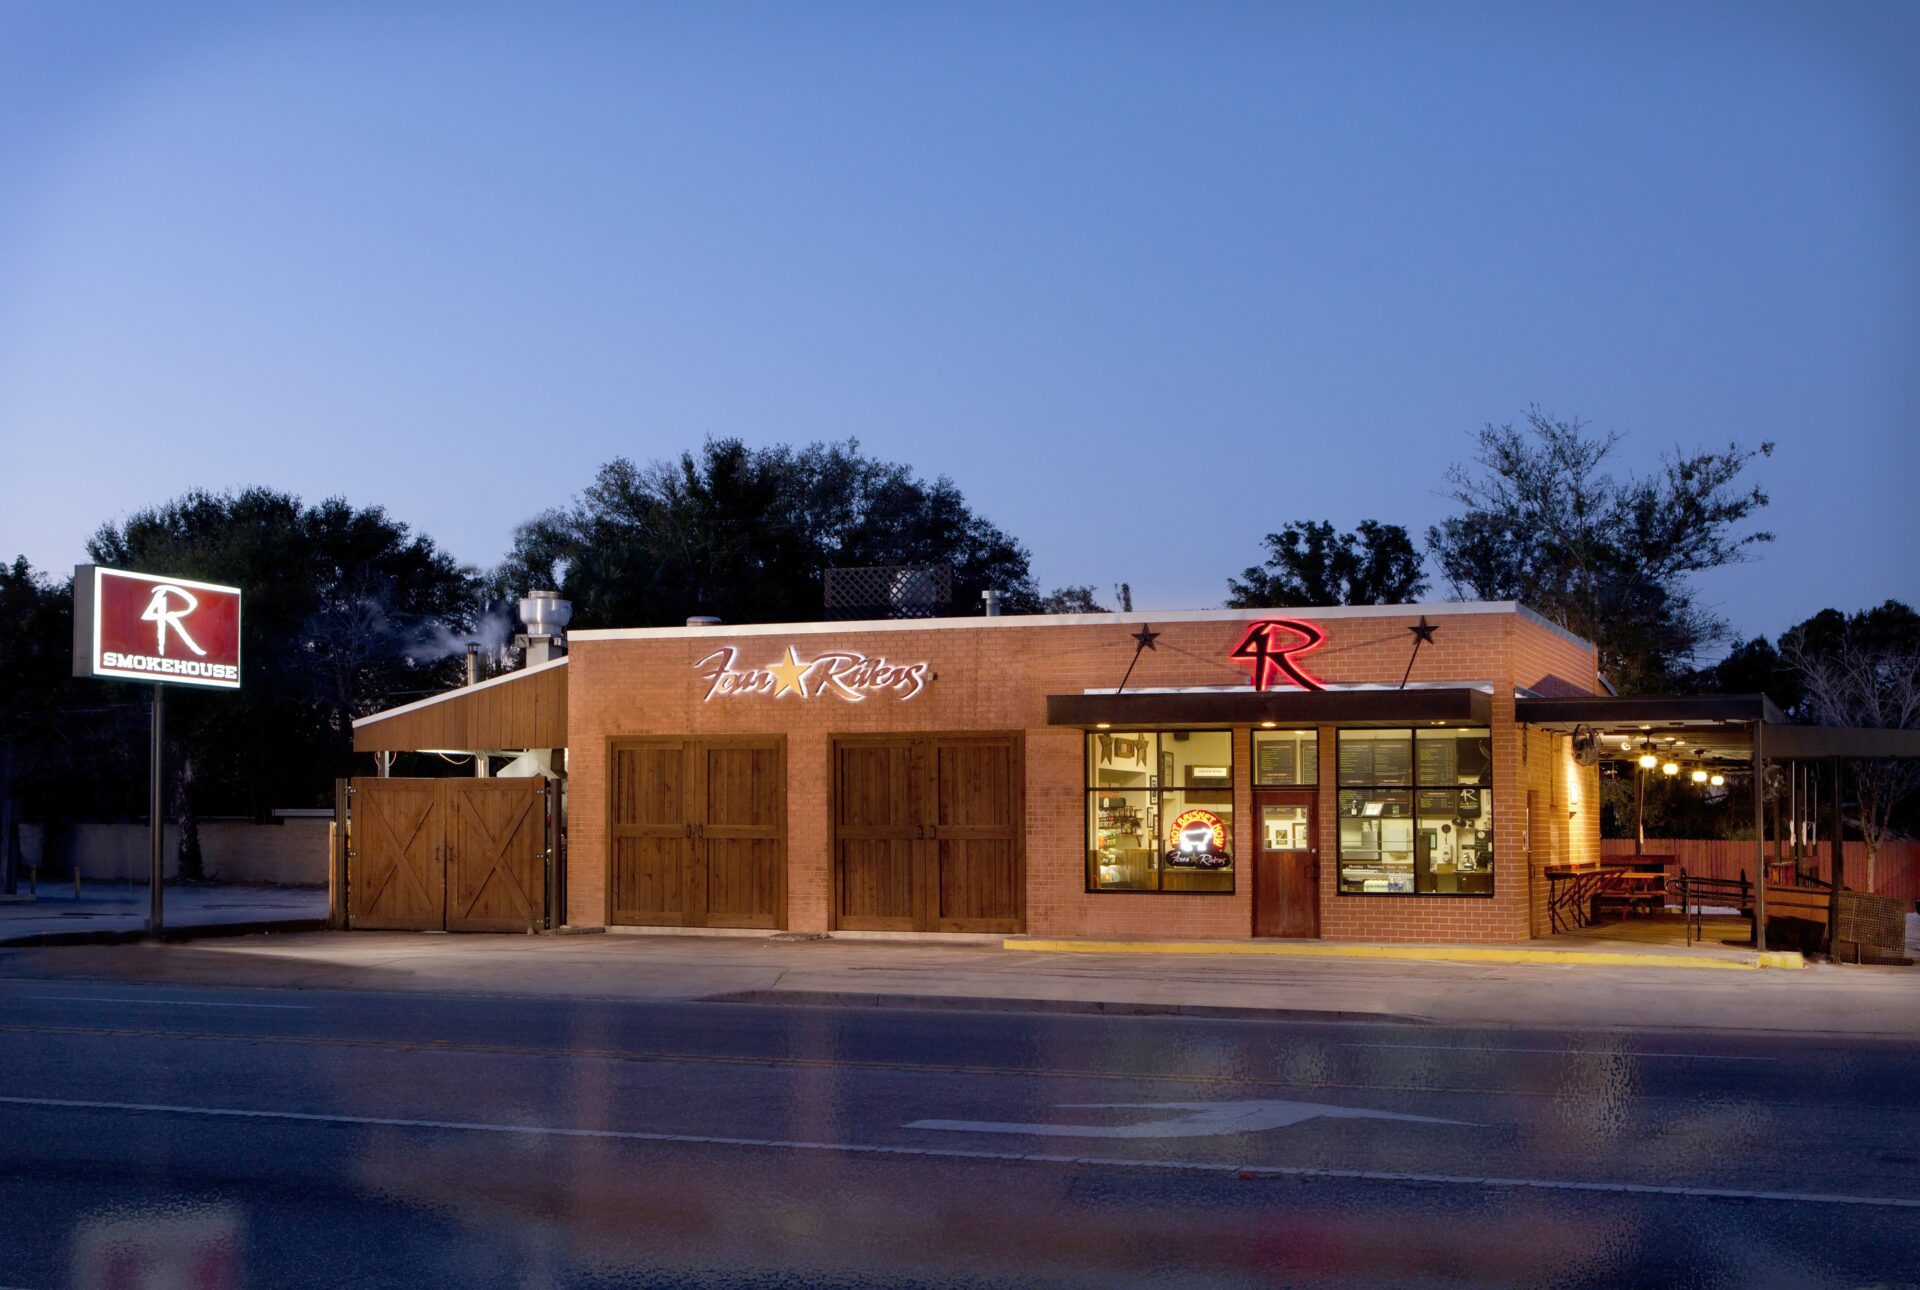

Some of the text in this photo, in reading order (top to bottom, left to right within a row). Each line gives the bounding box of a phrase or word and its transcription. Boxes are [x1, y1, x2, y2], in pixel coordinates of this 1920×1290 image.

[141, 585, 207, 656] 4R
[103, 652, 237, 680] SMOKEHOUSE
[694, 647, 930, 702] Four Rivers
[1230, 619, 1327, 691] 4R
[1171, 811, 1224, 847] HOT BRISKET NOW
